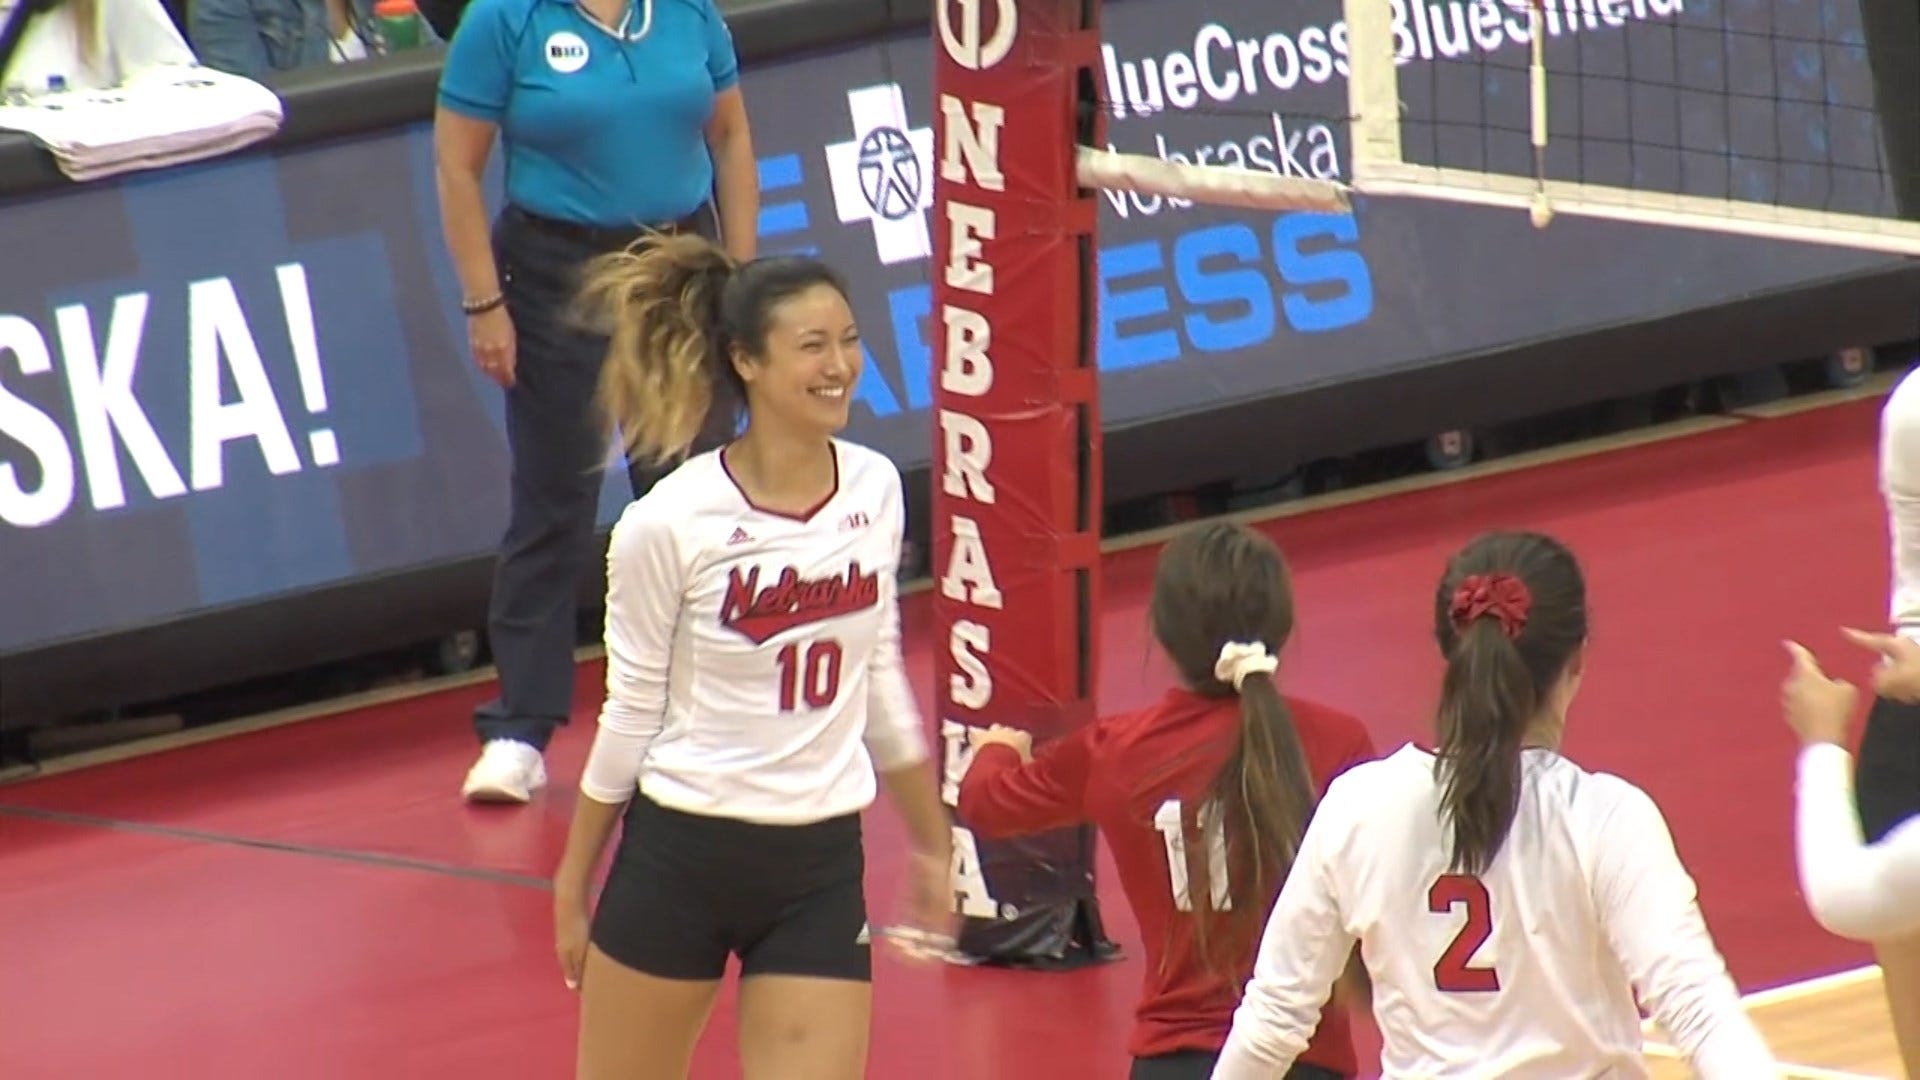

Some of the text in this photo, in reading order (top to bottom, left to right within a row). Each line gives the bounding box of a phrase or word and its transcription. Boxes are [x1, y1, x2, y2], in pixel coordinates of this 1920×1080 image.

[1101, 23, 1351, 120] lueCross
[0, 262, 341, 528] SKA!
[719, 560, 879, 632] Nebraska
[776, 638, 843, 712] 10
[1154, 798, 1233, 913] 11
[1428, 873, 1501, 992] 2
